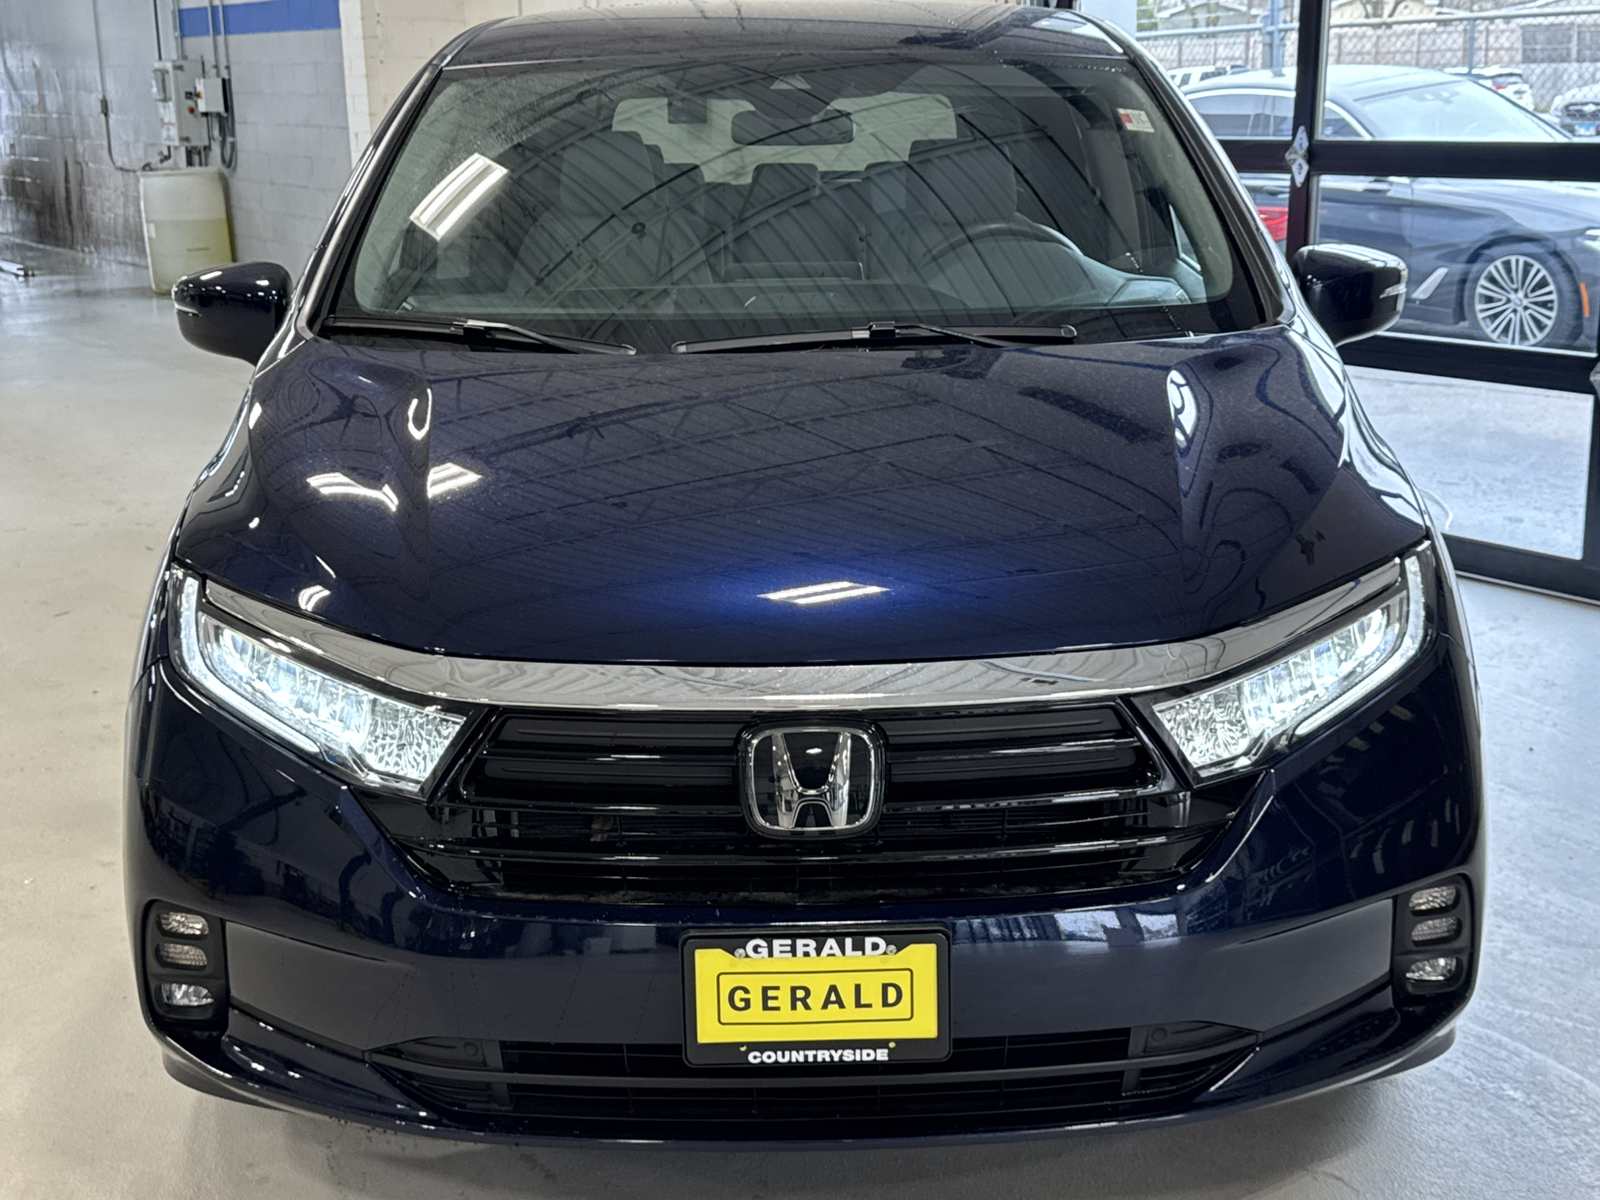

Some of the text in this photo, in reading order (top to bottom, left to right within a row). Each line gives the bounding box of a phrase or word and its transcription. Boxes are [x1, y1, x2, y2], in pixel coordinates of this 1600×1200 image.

[745, 936, 886, 959] GERALD
[727, 982, 903, 1012] GERALD
[747, 1048, 889, 1064] COUNTRYSIDE
